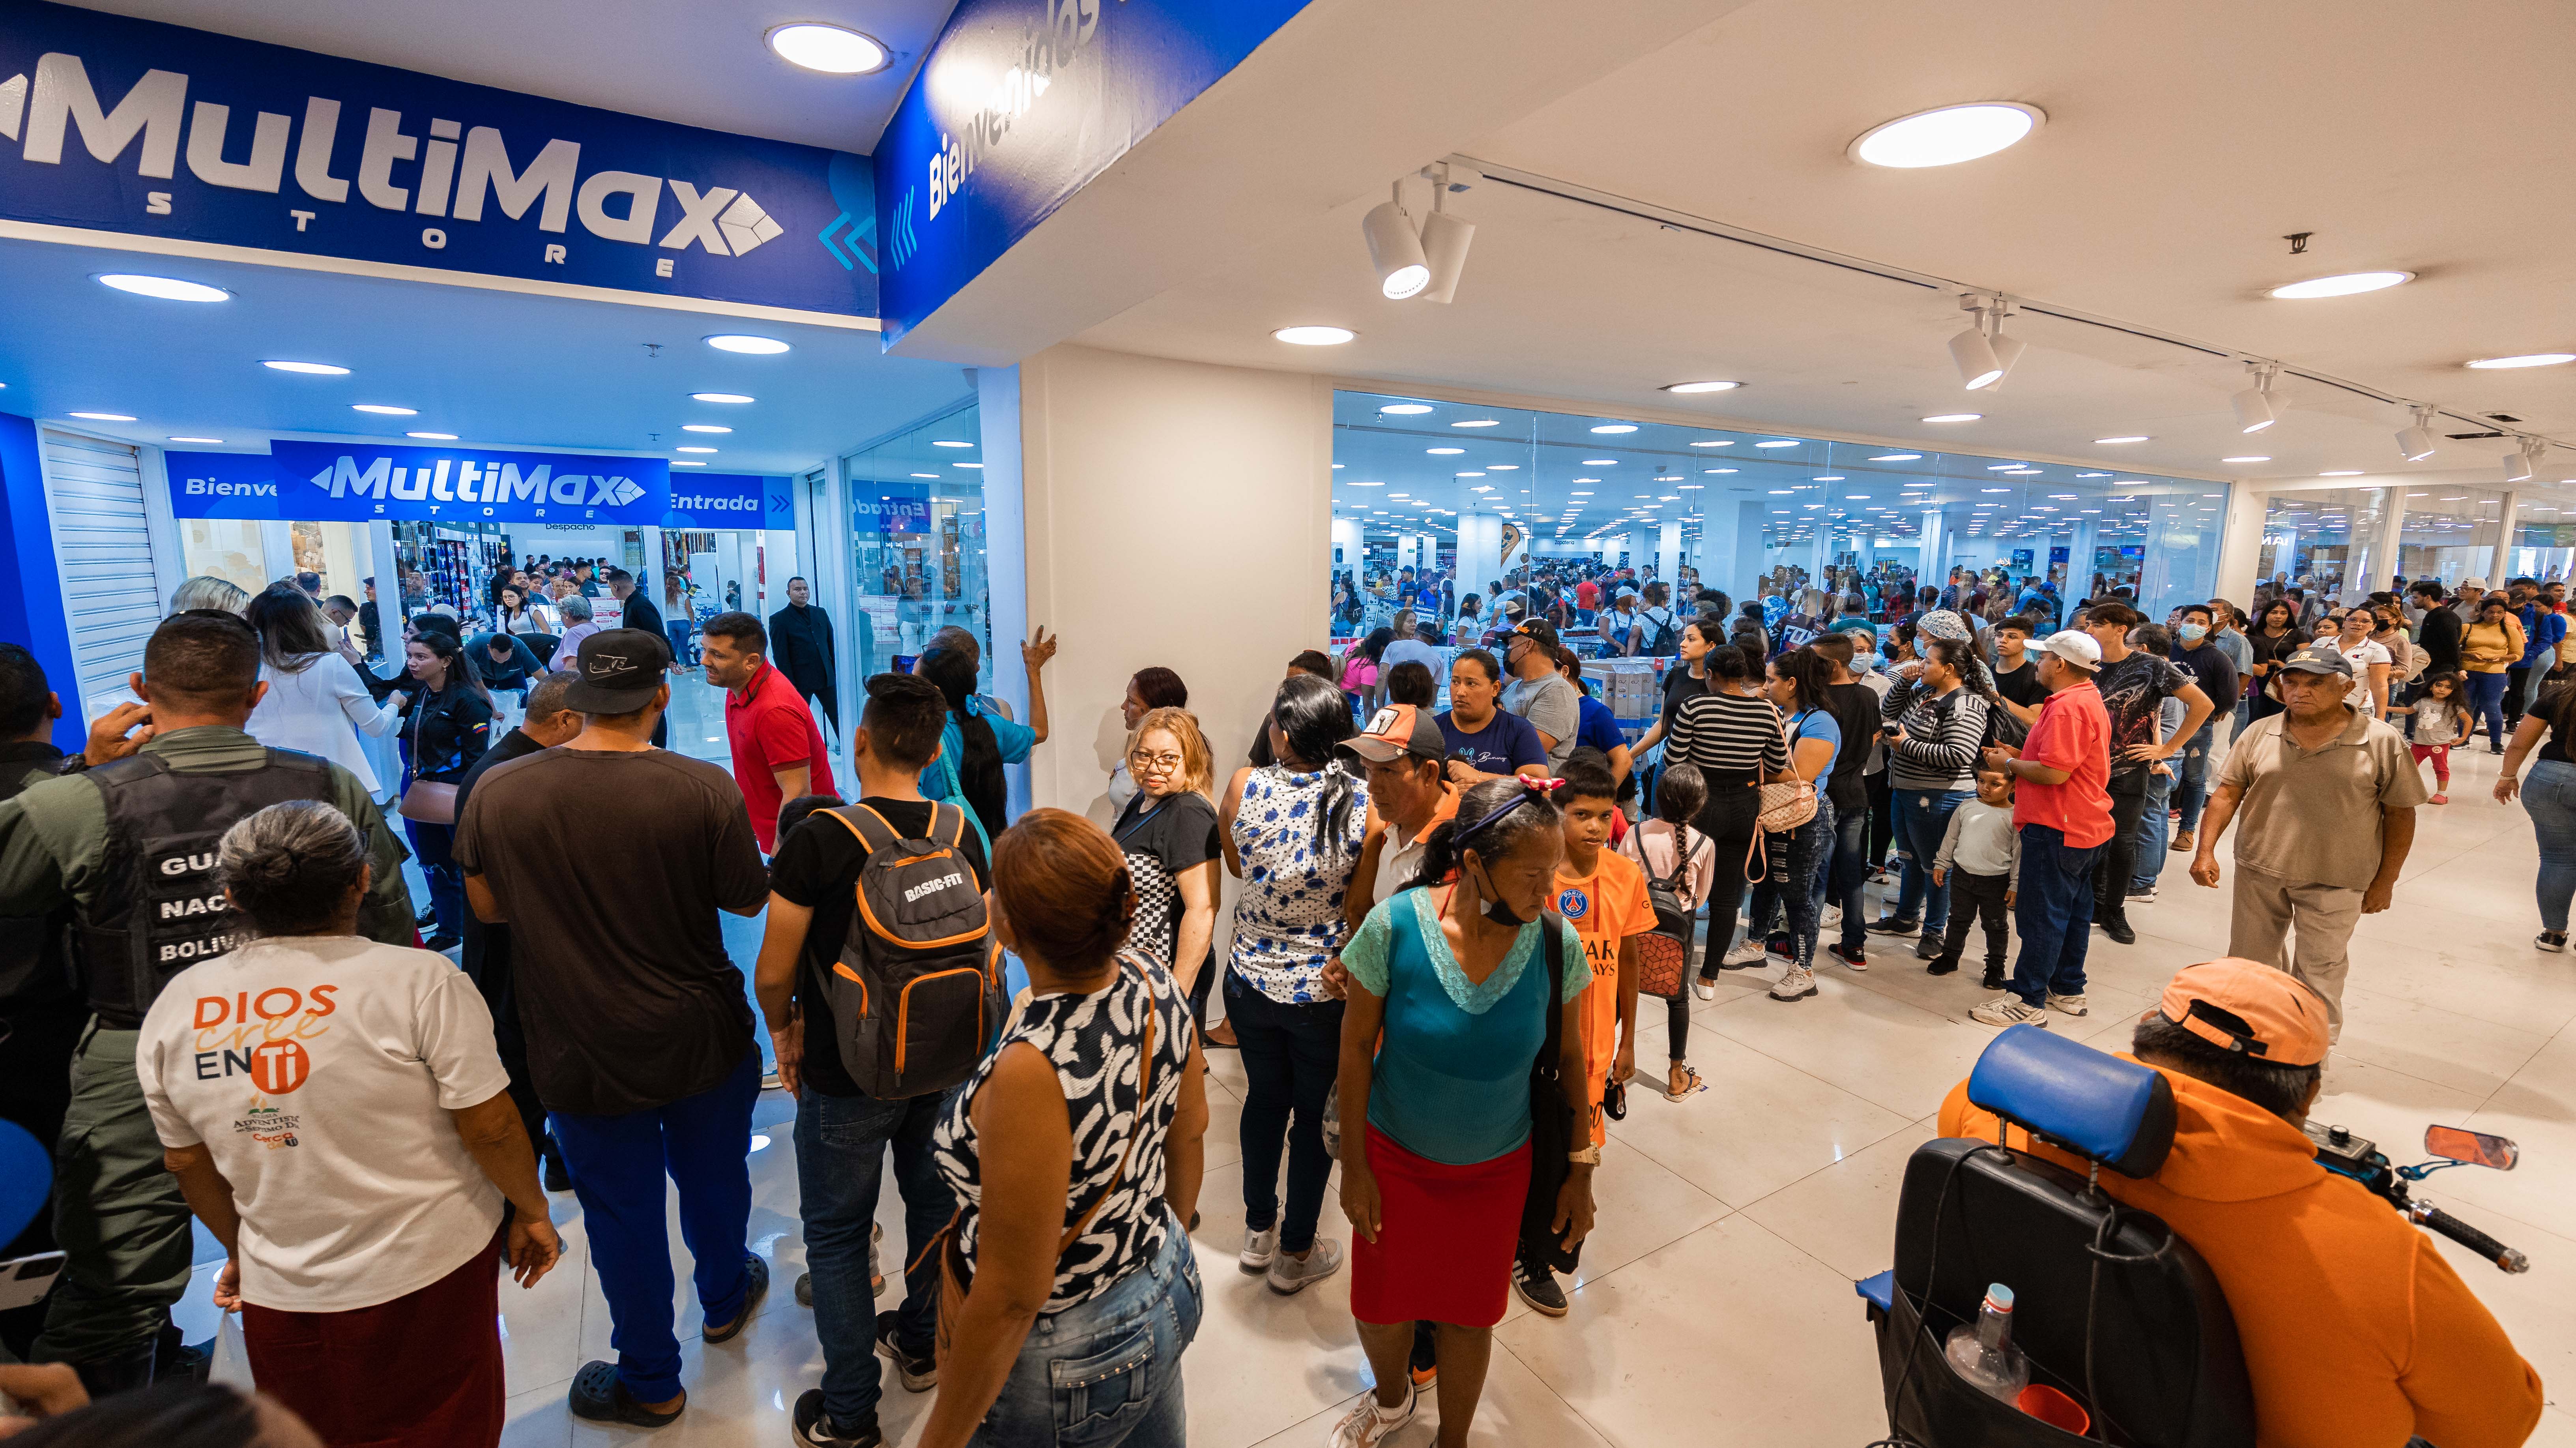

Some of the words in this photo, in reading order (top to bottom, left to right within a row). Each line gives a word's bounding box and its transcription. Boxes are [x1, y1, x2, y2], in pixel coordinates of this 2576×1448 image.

[23, 52, 739, 257] MultiMax
[330, 456, 625, 506] MultiMax
[671, 493, 758, 511] Entrada
[546, 523, 595, 532] Despacho
[1478, 752, 1507, 762] Bunny
[904, 873, 963, 903] BASIC-FIT
[1590, 963, 1615, 976] AYS
[193, 984, 339, 1029] DIOS
[195, 1012, 331, 1053] cree
[195, 1047, 252, 1081] EN
